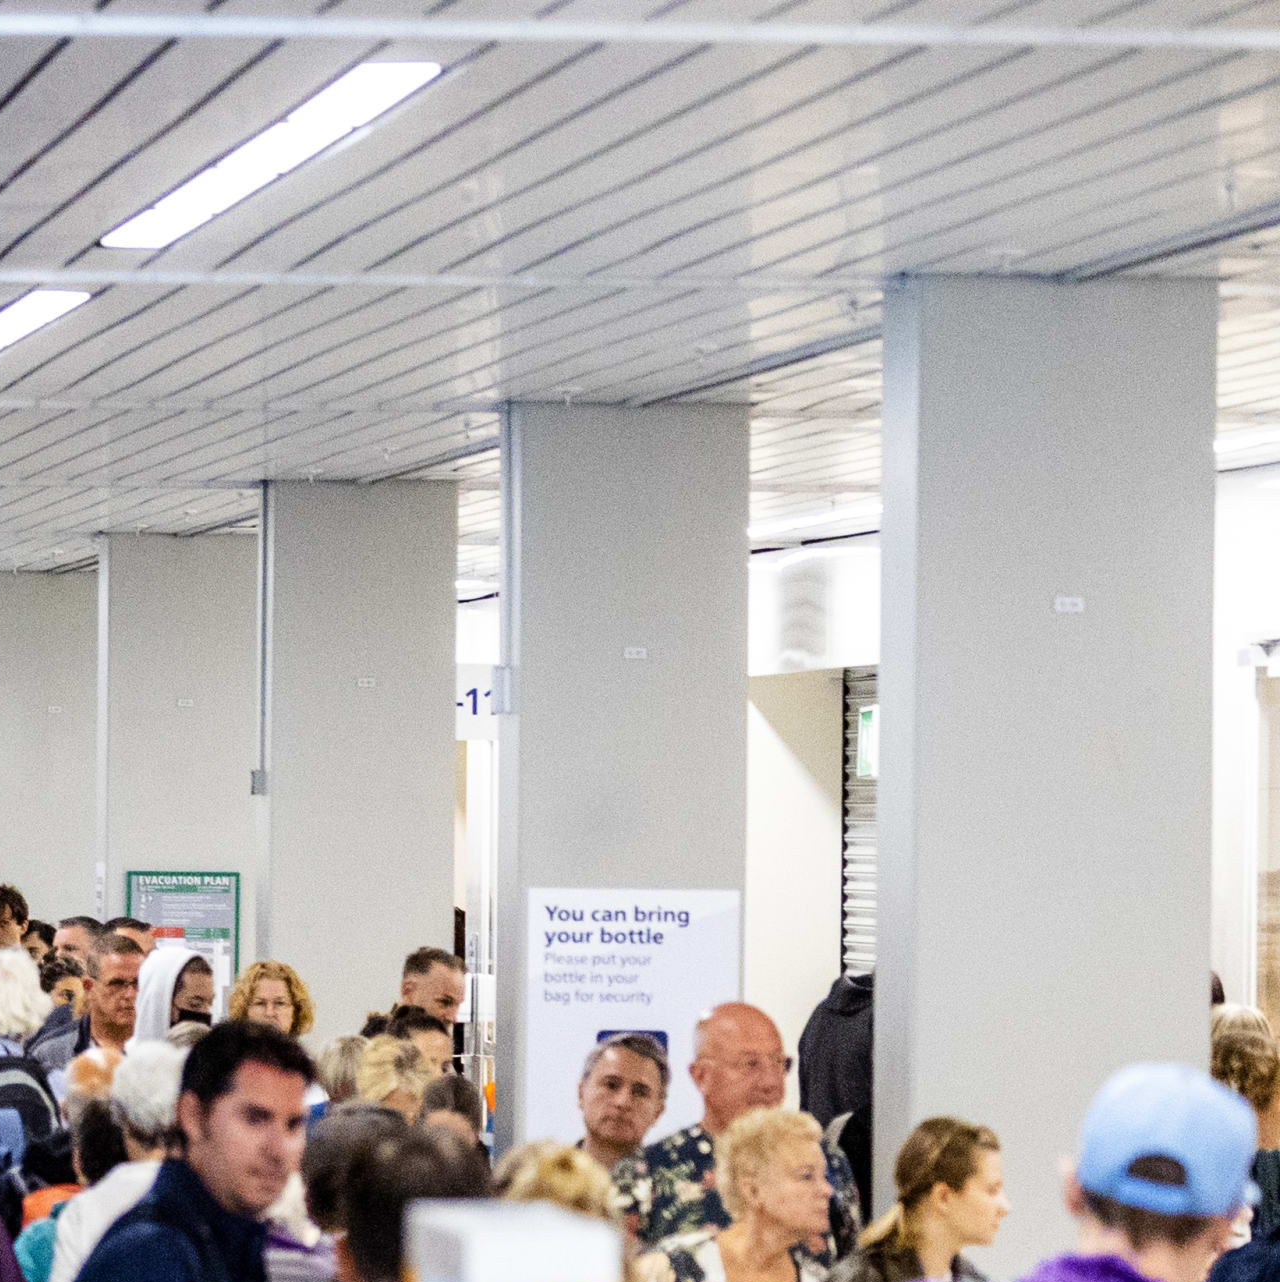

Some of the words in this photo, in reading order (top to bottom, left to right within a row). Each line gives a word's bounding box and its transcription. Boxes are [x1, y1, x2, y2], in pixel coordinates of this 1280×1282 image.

[138, 876, 201, 885] EVACUATION
[204, 876, 229, 886] PLAN
[545, 905, 584, 922] You
[591, 909, 627, 922] can
[634, 905, 690, 928] bring
[545, 930, 593, 948] your
[600, 927, 664, 945] bottle
[544, 953, 588, 965] Please
[591, 954, 616, 967] put
[619, 955, 652, 968] your
[544, 971, 586, 984] bottle
[590, 972, 604, 984] in
[608, 973, 639, 987] your
[544, 989, 571, 1006] bag
[574, 989, 594, 1002] for
[599, 990, 654, 1006] security
